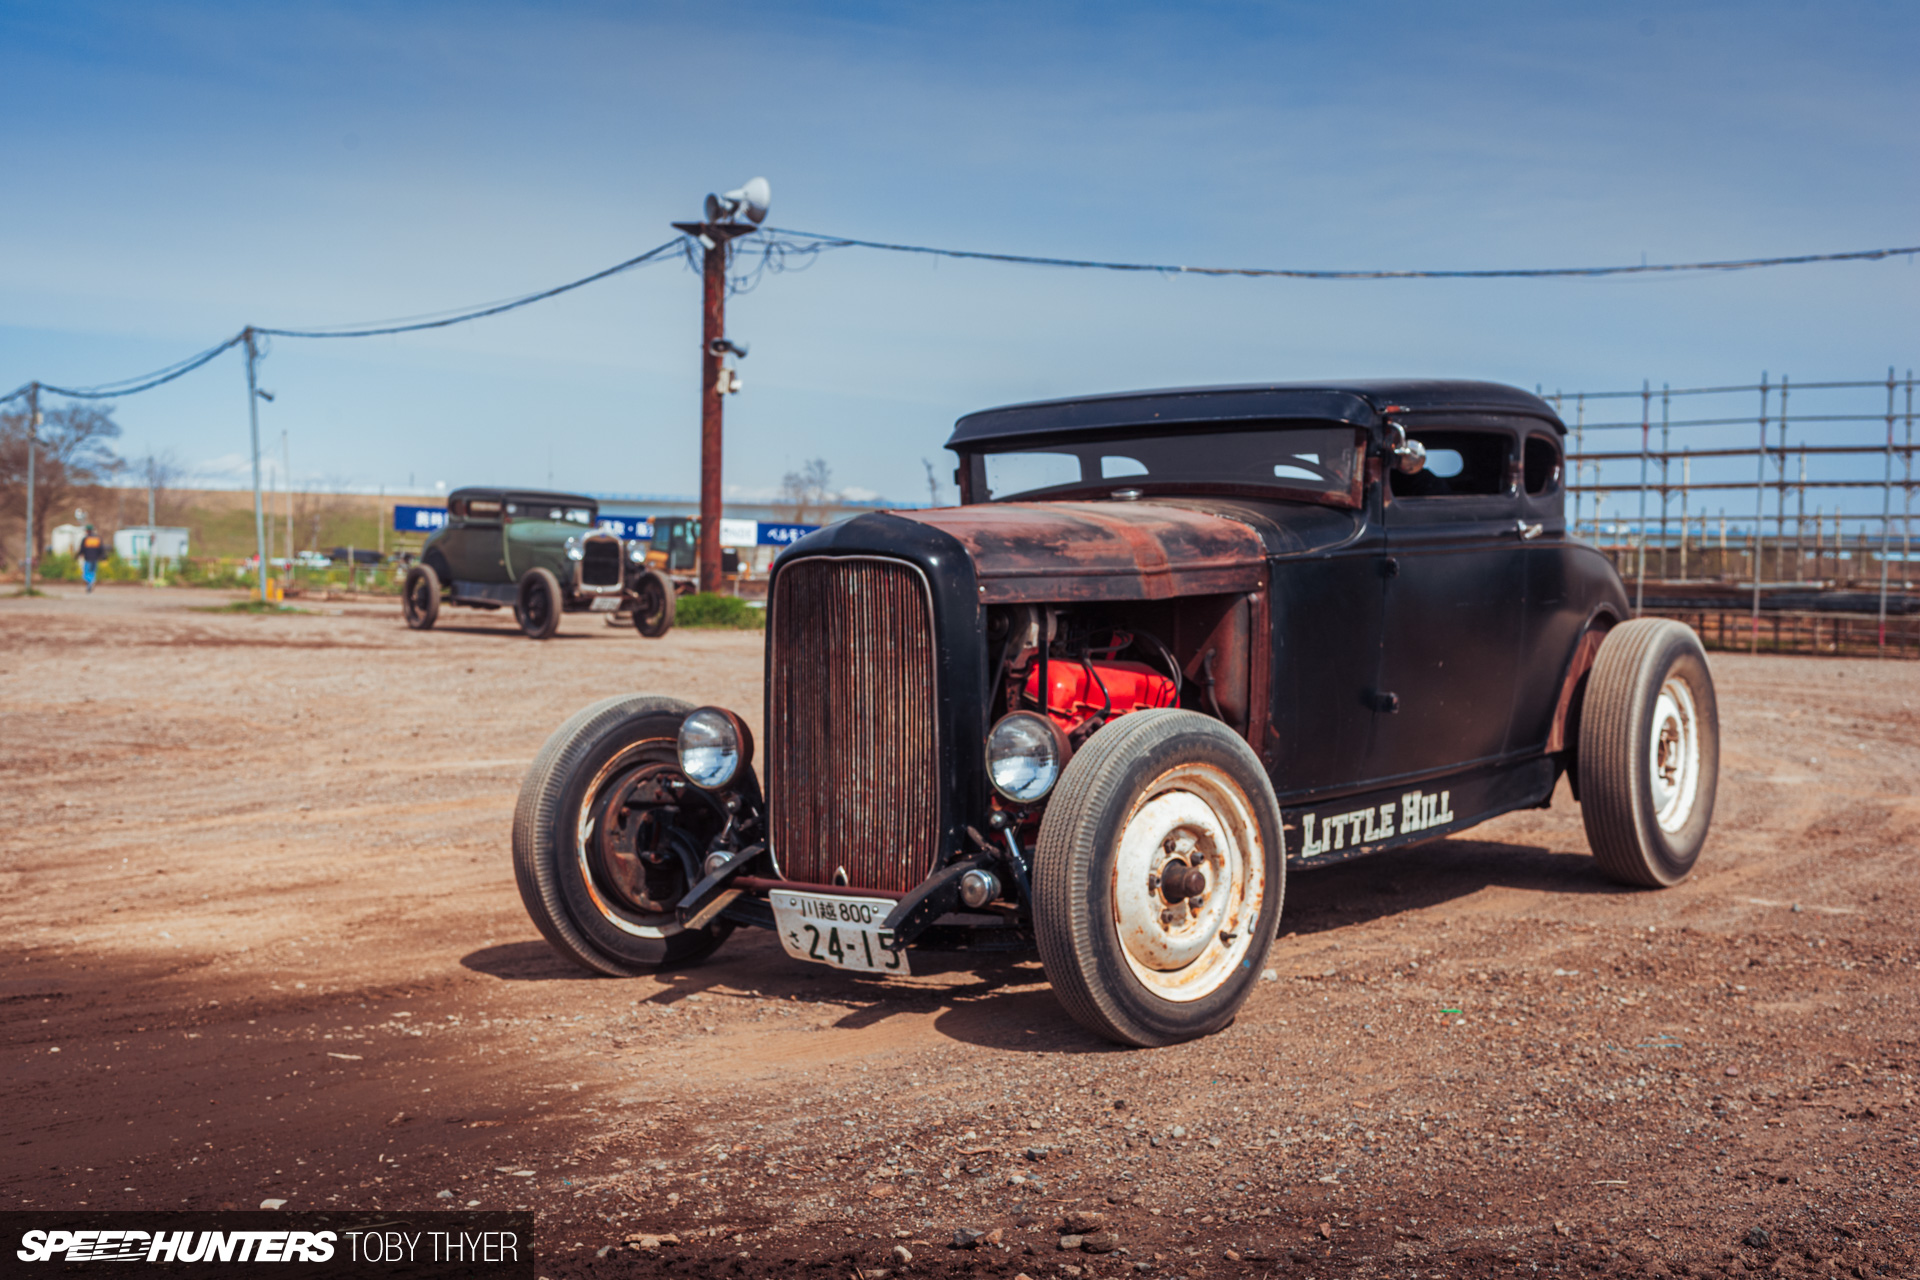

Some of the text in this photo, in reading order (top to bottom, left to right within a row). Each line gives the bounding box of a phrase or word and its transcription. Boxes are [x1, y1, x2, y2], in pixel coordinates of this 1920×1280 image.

[1302, 790, 1454, 858] LITTLE HILL
[838, 903, 872, 924] 800
[803, 924, 900, 969] 24-15
